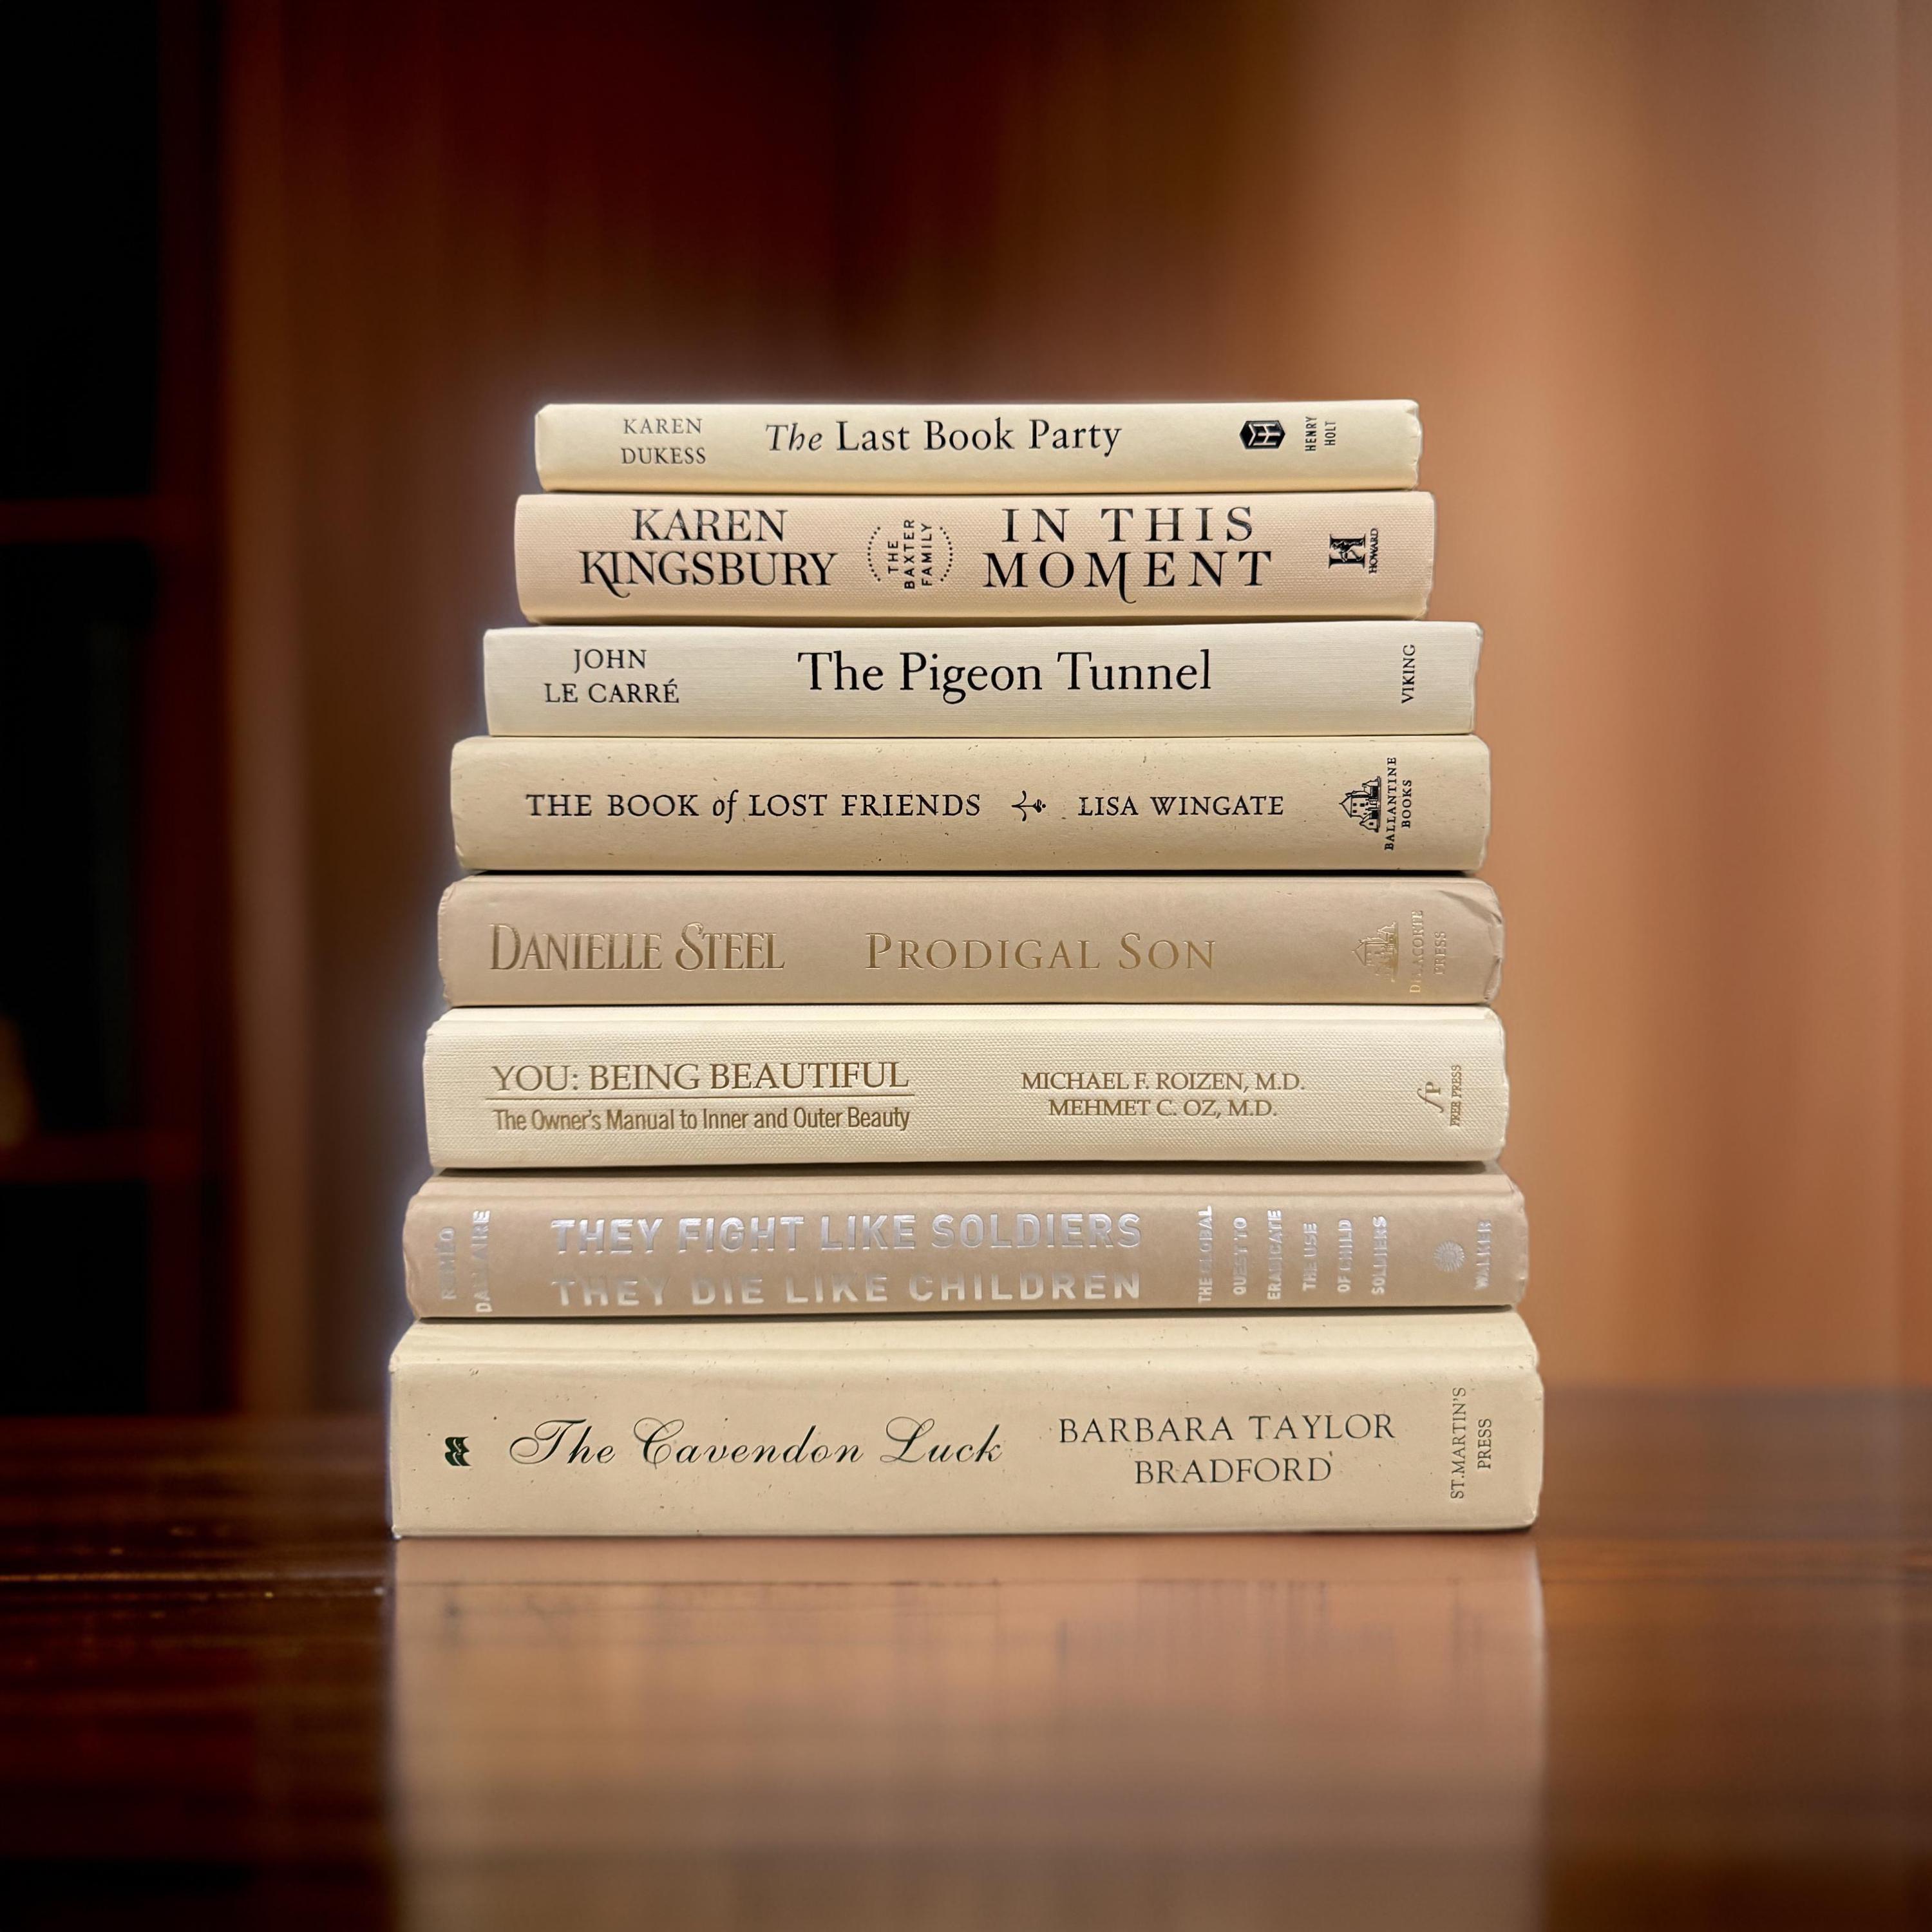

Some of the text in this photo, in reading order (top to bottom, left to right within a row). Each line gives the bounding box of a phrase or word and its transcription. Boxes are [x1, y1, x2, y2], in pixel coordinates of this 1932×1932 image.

[623, 418, 702, 434] KAREN
[766, 417, 1122, 457] The Last Book Party
[1305, 417, 1316, 451] HENRY
[1324, 421, 1336, 446] HOLT
[621, 447, 706, 464] DUKESS
[631, 509, 788, 542] KAREN
[1001, 507, 1252, 542] IN THIS
[887, 541, 899, 574] THE
[904, 520, 915, 589] BAXTER
[921, 524, 933, 586] FAMILY
[1368, 528, 1378, 574] HOWARD
[580, 551, 838, 598] KINGSBURY
[983, 551, 1271, 603] MOMENT
[574, 649, 647, 674] JOHN
[798, 649, 1211, 705] The Pigeon Tunnel
[1401, 645, 1415, 703] VIKING
[544, 678, 679, 703] LE CARRÉ
[526, 790, 980, 824] THE BOOK of LOST FRIENDS
[1078, 795, 1283, 816] LISA WINGATE
[1384, 757, 1397, 851] BALLANTINE
[1401, 780, 1412, 828] BOOKS
[489, 922, 785, 971] DANIELLE STEEL
[866, 933, 1216, 970] PRODIGAL SON
[1434, 931, 1446, 974] PRESS
[491, 1061, 909, 1092] YOU: BEING BEAUTIFUL
[1021, 1072, 1305, 1094] MICHAEL F. ROIZEN, M.D.
[1450, 1065, 1461, 1126] FREE PRESS
[492, 1108, 910, 1132] The Owner's Manual to Inner and Outer Beauty
[1048, 1099, 1278, 1119] MEHMET C. OZ, M.D.
[551, 1212, 1142, 1255] THEY FIGHT LIKE SOLDIERS
[471, 1211, 493, 1312] DAAIRE
[1233, 1217, 1247, 1295] QUEST TO
[1267, 1209, 1282, 1300] ERADICATE
[1302, 1223, 1317, 1291] THE USE
[1337, 1219, 1352, 1293] OF CHILD
[1372, 1216, 1387, 1295] SOLDIERS
[551, 1271, 1141, 1307] THEY DIE LIKE CHILDREN
[1198, 1277, 1212, 1303] THE
[509, 1417, 1002, 1469] The Cavendon Luck
[1059, 1414, 1395, 1443] BARBARA TAYLOR
[1477, 1419, 1492, 1469] PRESS
[1135, 1457, 1332, 1484] BRADFORD
